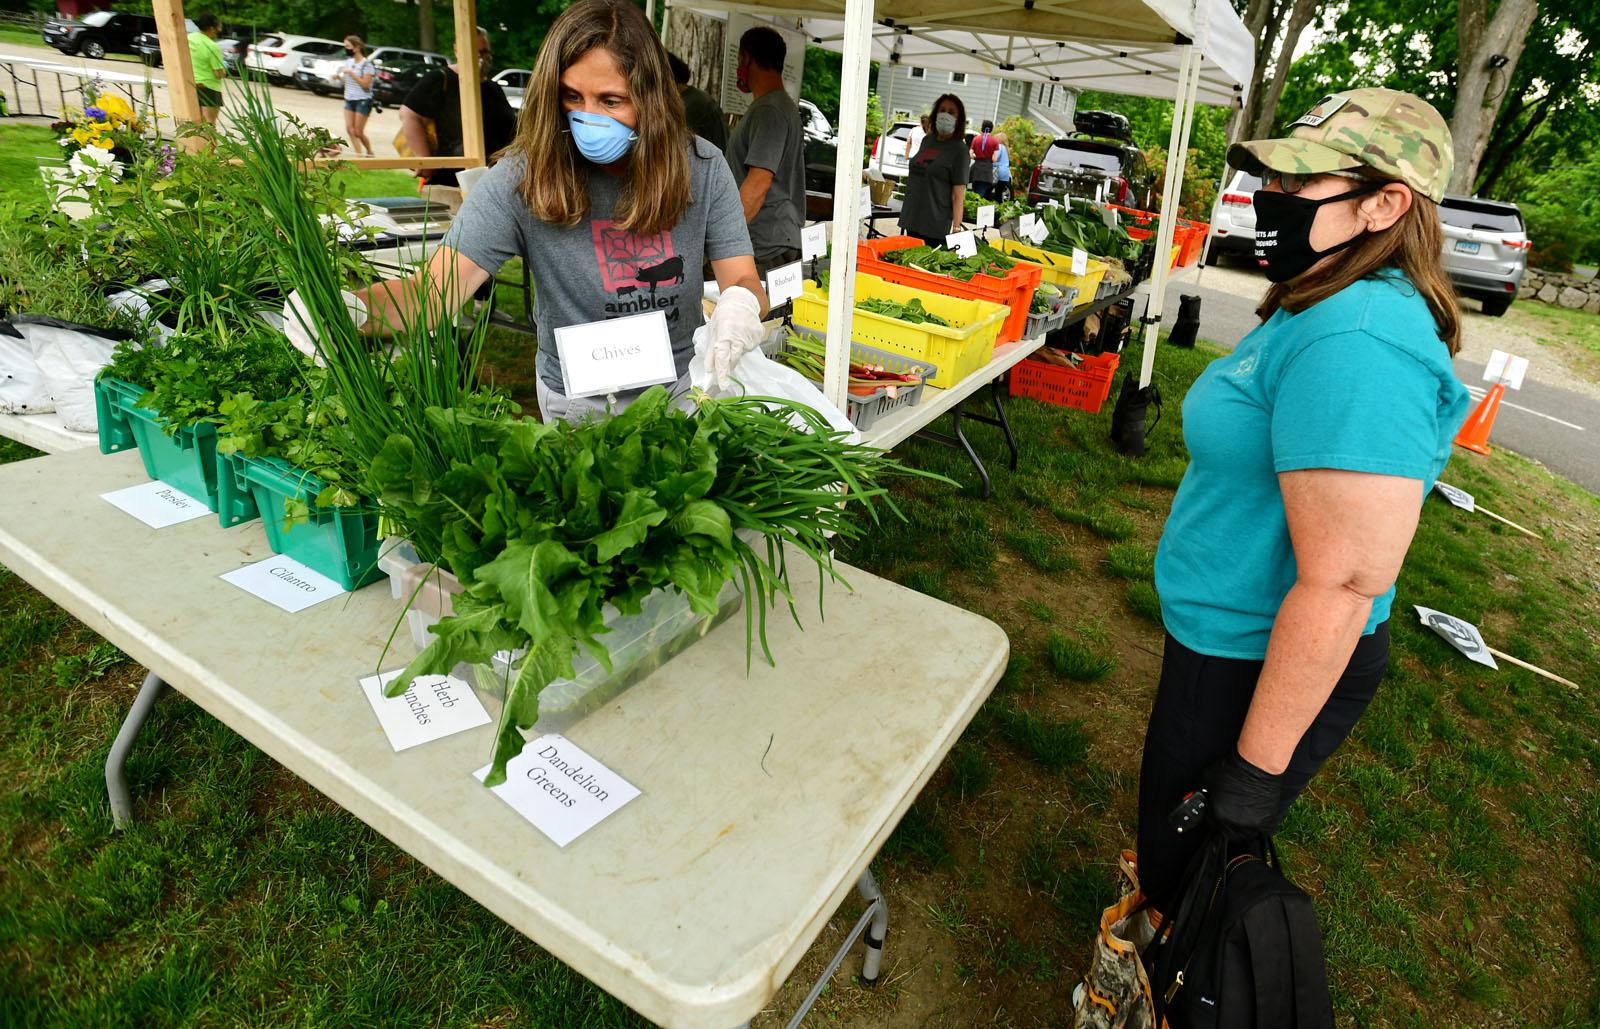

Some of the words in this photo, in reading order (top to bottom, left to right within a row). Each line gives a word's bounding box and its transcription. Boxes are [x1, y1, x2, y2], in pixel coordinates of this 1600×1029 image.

[605, 294, 679, 313] ambler
[591, 344, 642, 362] Chives
[155, 489, 191, 510] Parsley
[269, 567, 317, 594] Cilantro
[431, 681, 458, 708] Herb
[526, 767, 577, 808] Greens
[537, 746, 609, 803] Dandelion
